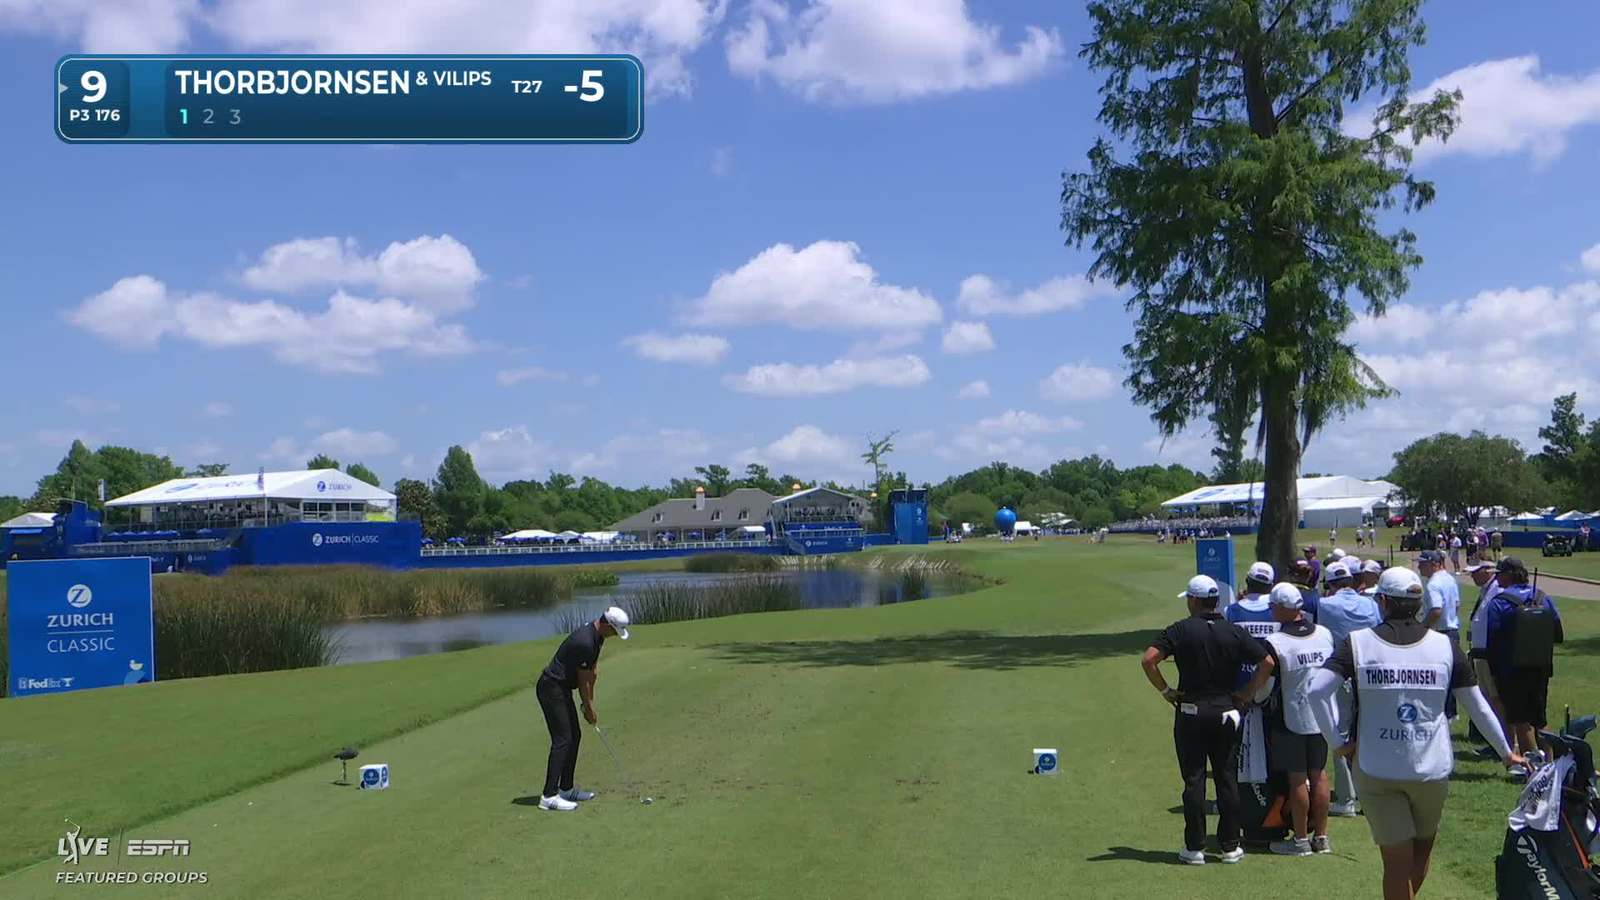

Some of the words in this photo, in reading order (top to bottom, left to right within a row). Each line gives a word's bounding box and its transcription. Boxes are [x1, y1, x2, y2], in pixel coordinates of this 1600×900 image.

[325, 535, 352, 544] ZURICH
[354, 535, 380, 544] CLASSIC
[47, 613, 114, 628] ZURICH
[47, 637, 115, 653] CLASSIC
[1297, 651, 1324, 665] VILIPS
[1366, 669, 1437, 685] THORBJORNSEN
[1379, 727, 1432, 741] ZURICH
